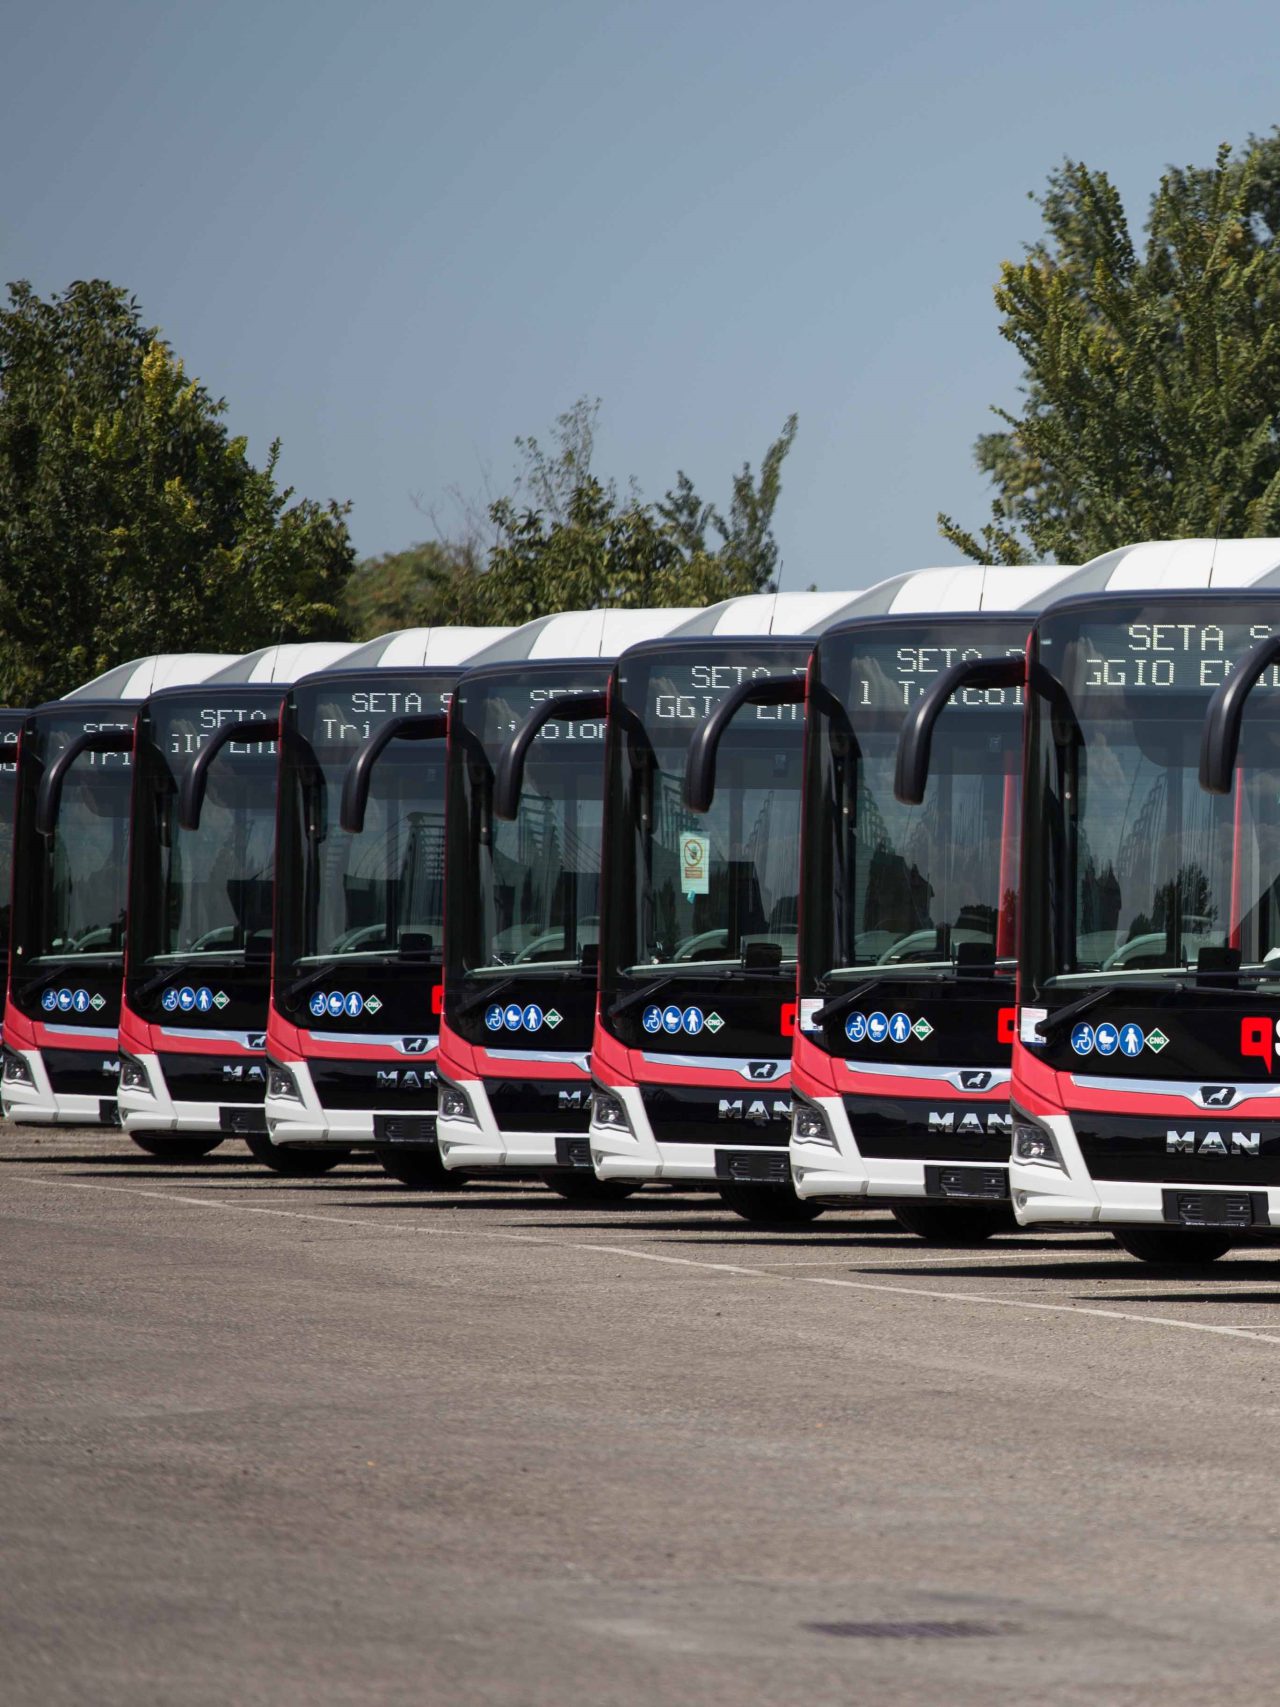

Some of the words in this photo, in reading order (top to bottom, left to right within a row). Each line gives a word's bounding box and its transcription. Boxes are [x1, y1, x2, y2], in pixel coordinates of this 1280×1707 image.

[1128, 624, 1224, 651] SETA
[351, 692, 422, 713] SETA
[655, 695, 721, 718] GGI
[1149, 1036, 1165, 1045] CNG
[718, 1099, 793, 1120] MAN
[928, 1111, 1013, 1134] MAN
[1166, 1130, 1261, 1155] MAN
